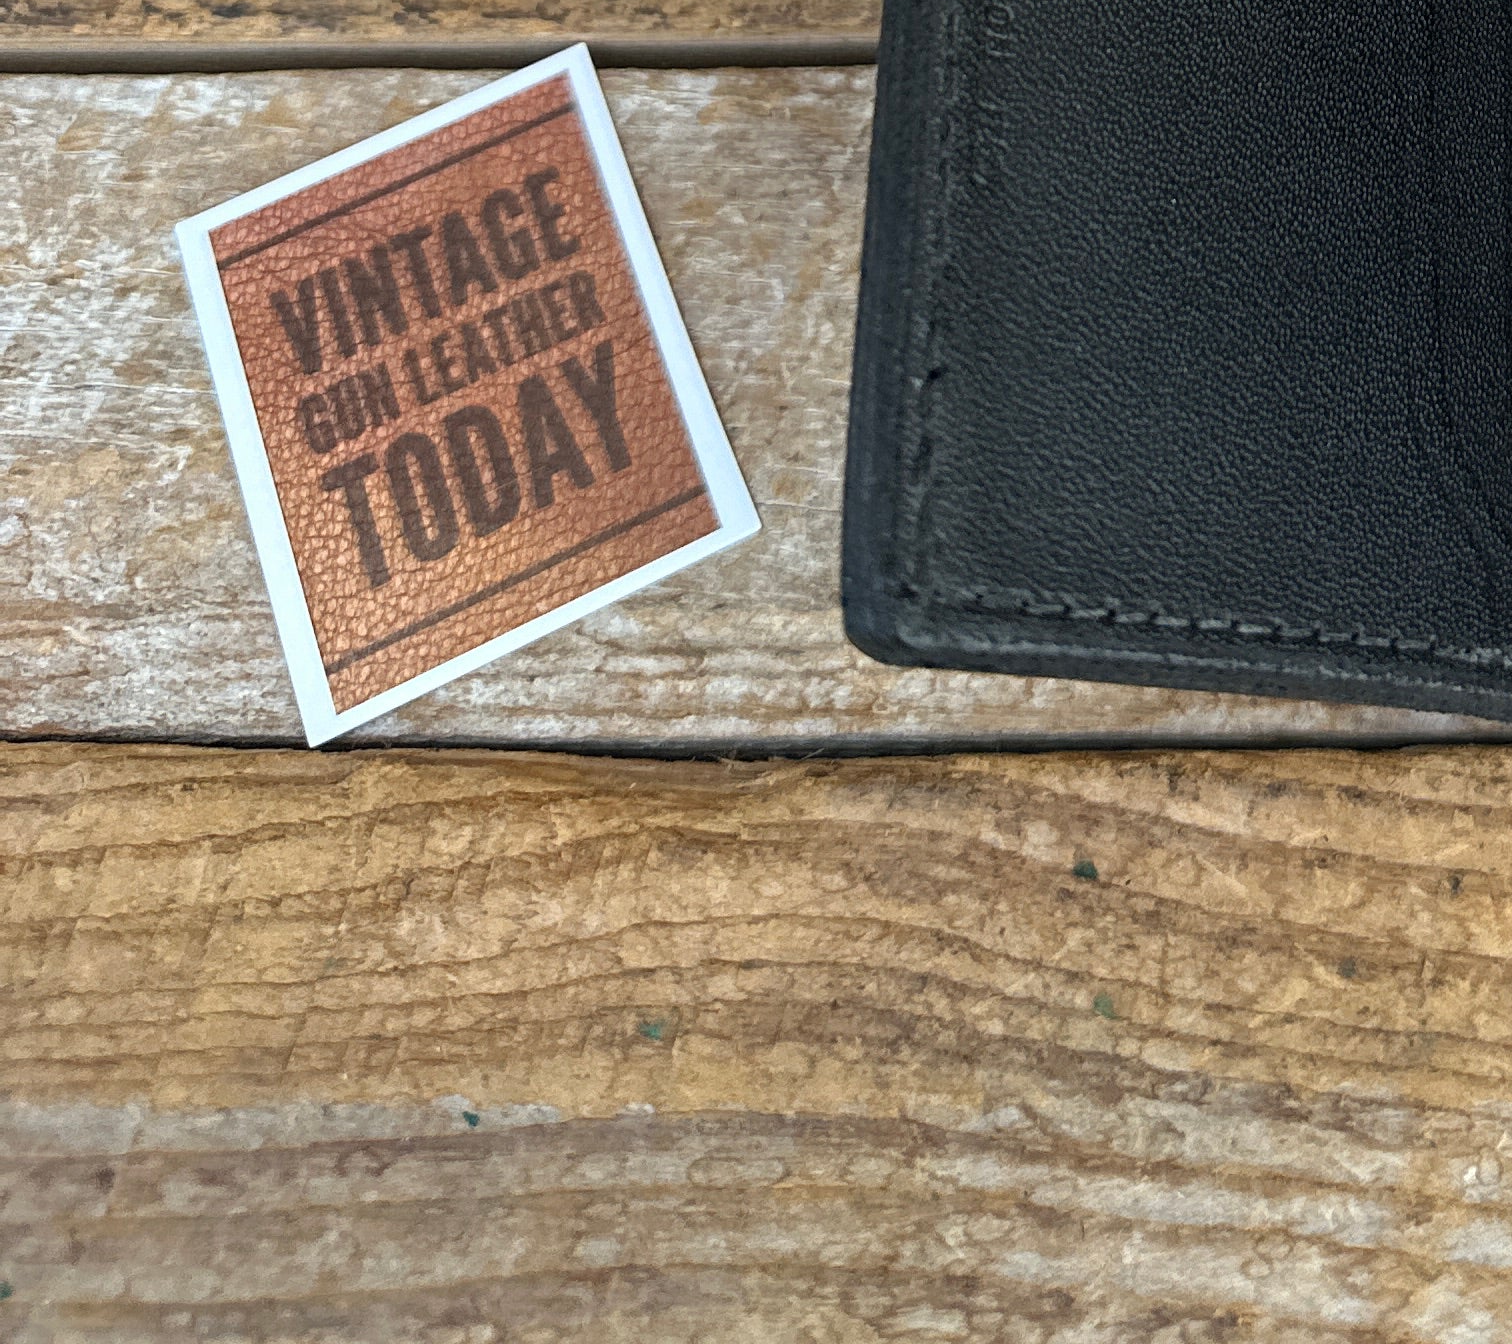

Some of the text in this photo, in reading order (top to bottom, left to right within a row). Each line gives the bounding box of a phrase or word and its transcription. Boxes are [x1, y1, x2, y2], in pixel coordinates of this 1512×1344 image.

[269, 165, 583, 375] VINTAGE
[301, 269, 607, 455] GUN LEATHER
[322, 340, 633, 590] TODAY
